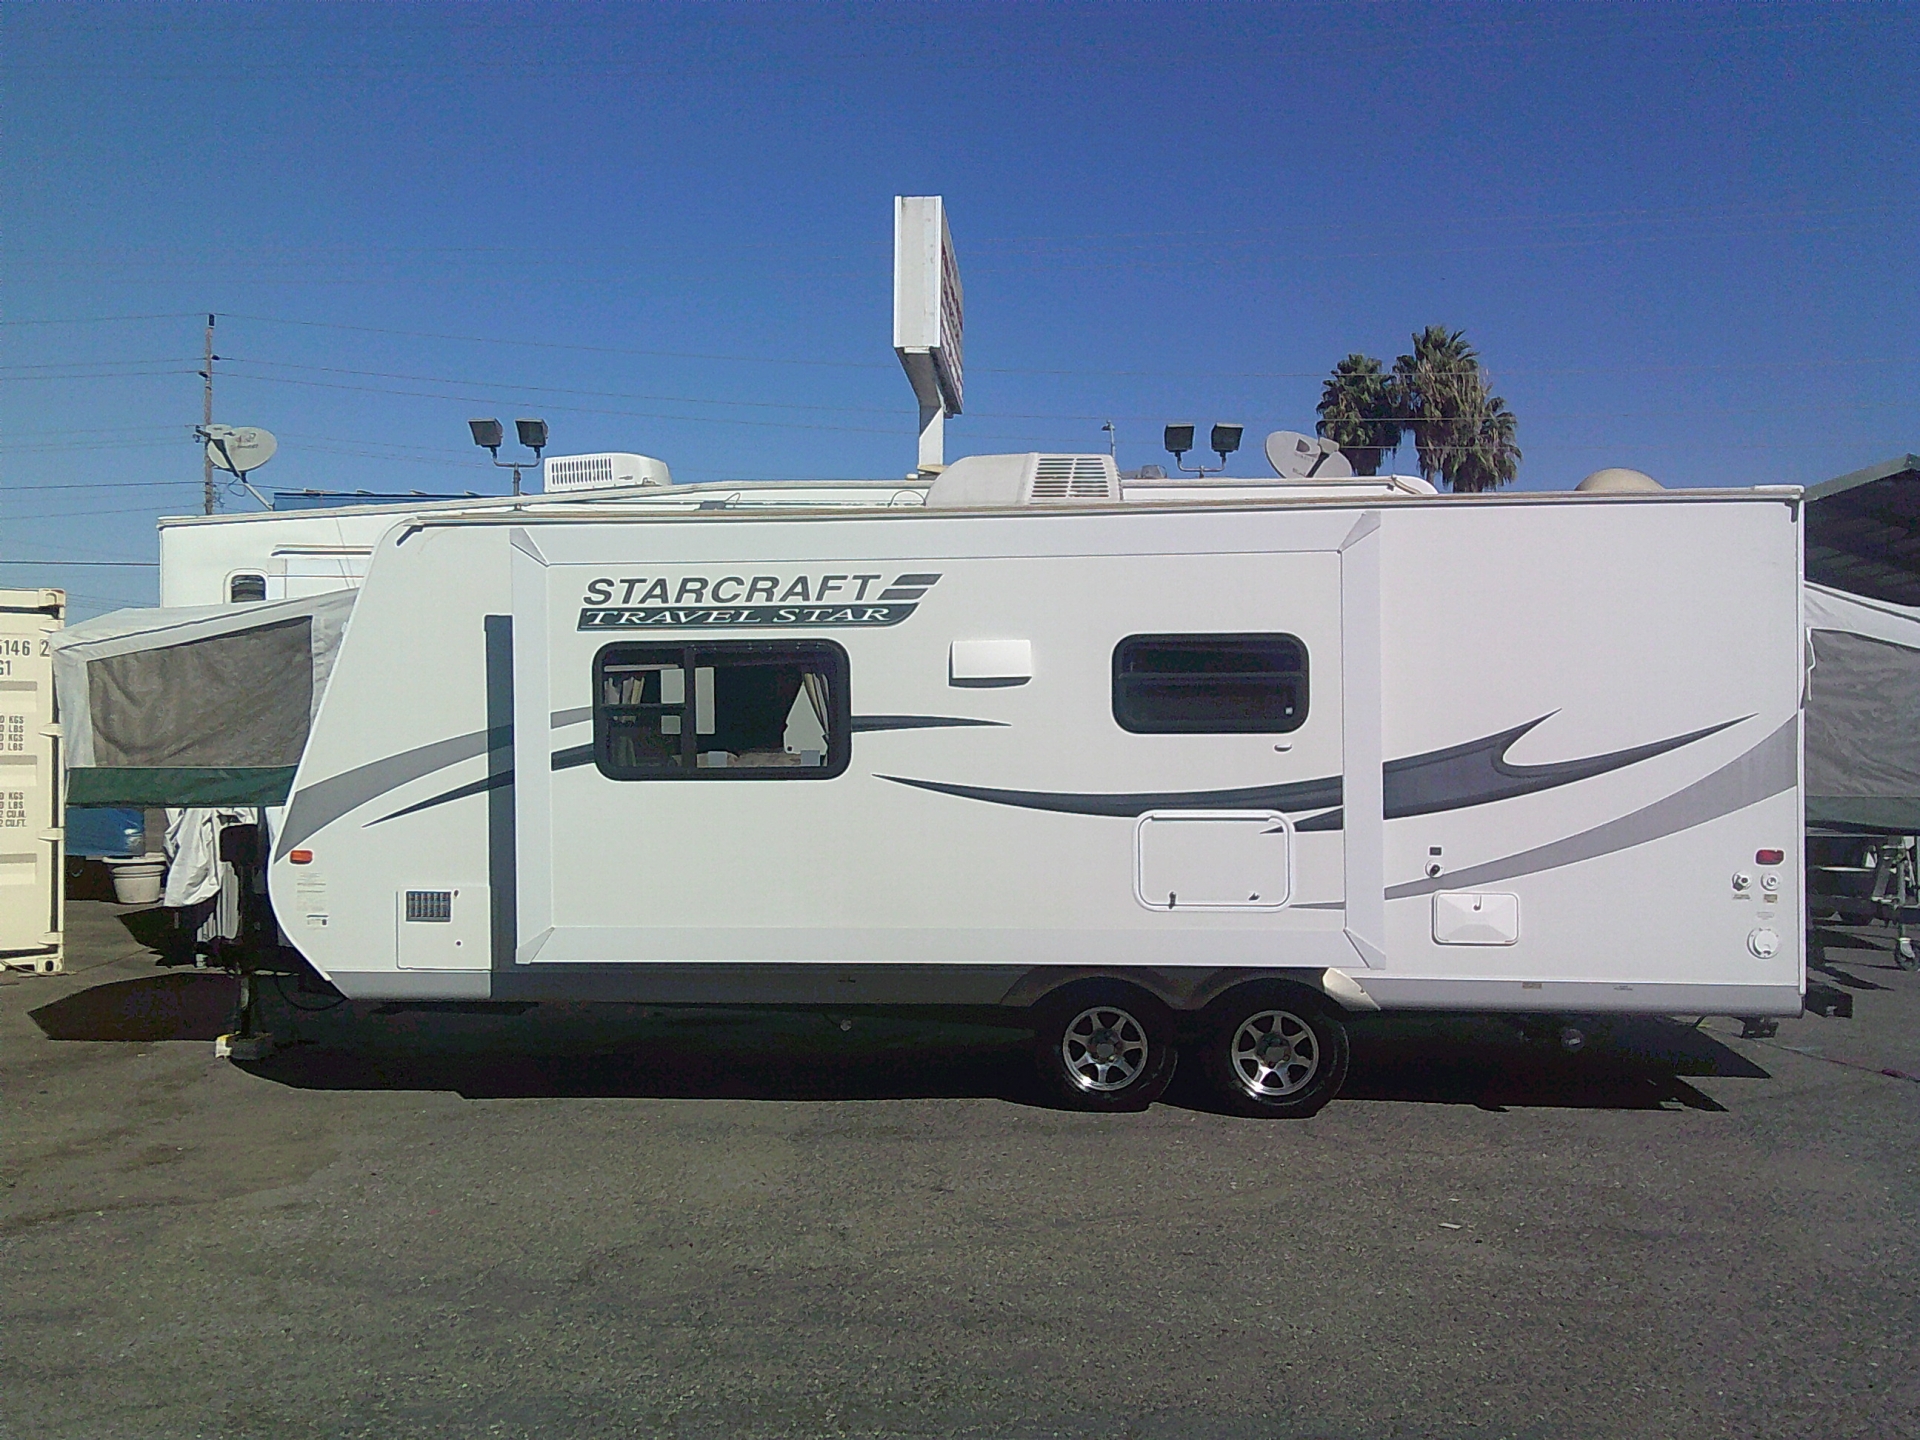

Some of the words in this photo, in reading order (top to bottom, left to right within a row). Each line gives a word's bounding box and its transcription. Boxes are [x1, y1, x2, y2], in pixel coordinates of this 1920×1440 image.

[583, 574, 882, 605] STARCRAFT
[586, 609, 762, 625] TRAVEL
[773, 608, 890, 623] STAR
[0, 639, 31, 656] 146
[40, 640, 50, 657] 2
[9, 715, 24, 724] KGS
[9, 724, 24, 733] LBS
[8, 733, 24, 742] KGS
[8, 742, 23, 751] LBS
[8, 791, 24, 801] KGS
[8, 800, 24, 810] LBS
